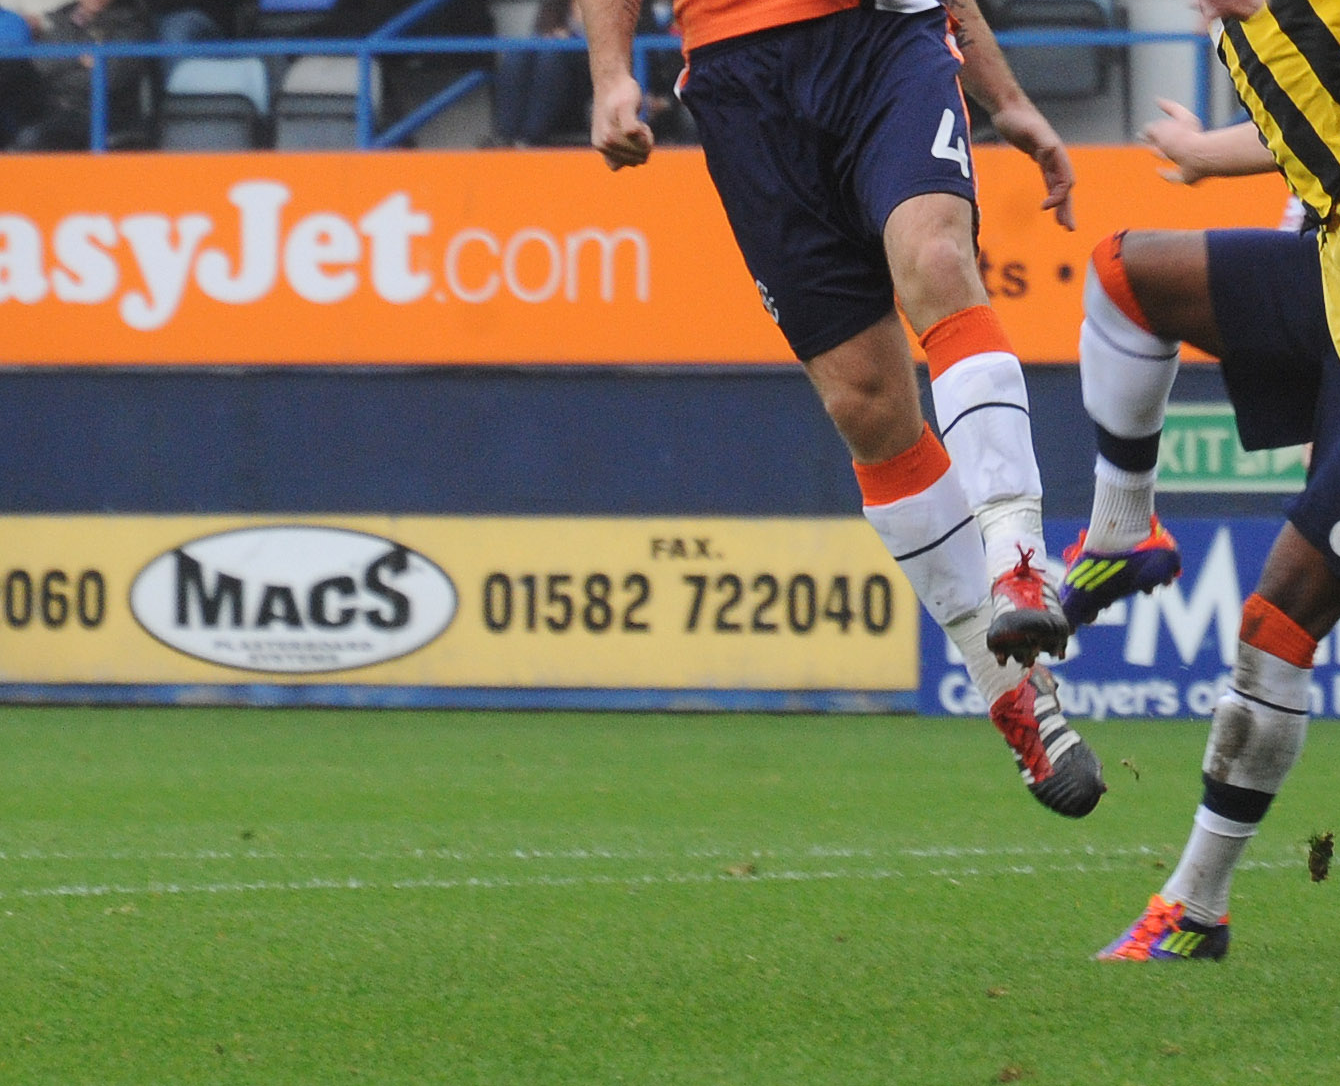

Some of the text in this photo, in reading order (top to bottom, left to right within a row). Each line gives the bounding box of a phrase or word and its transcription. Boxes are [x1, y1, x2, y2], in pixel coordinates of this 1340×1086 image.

[931, 108, 970, 179] 4
[5, 568, 106, 630] 060
[481, 572, 653, 635] 01582
[682, 571, 894, 635] 722040
